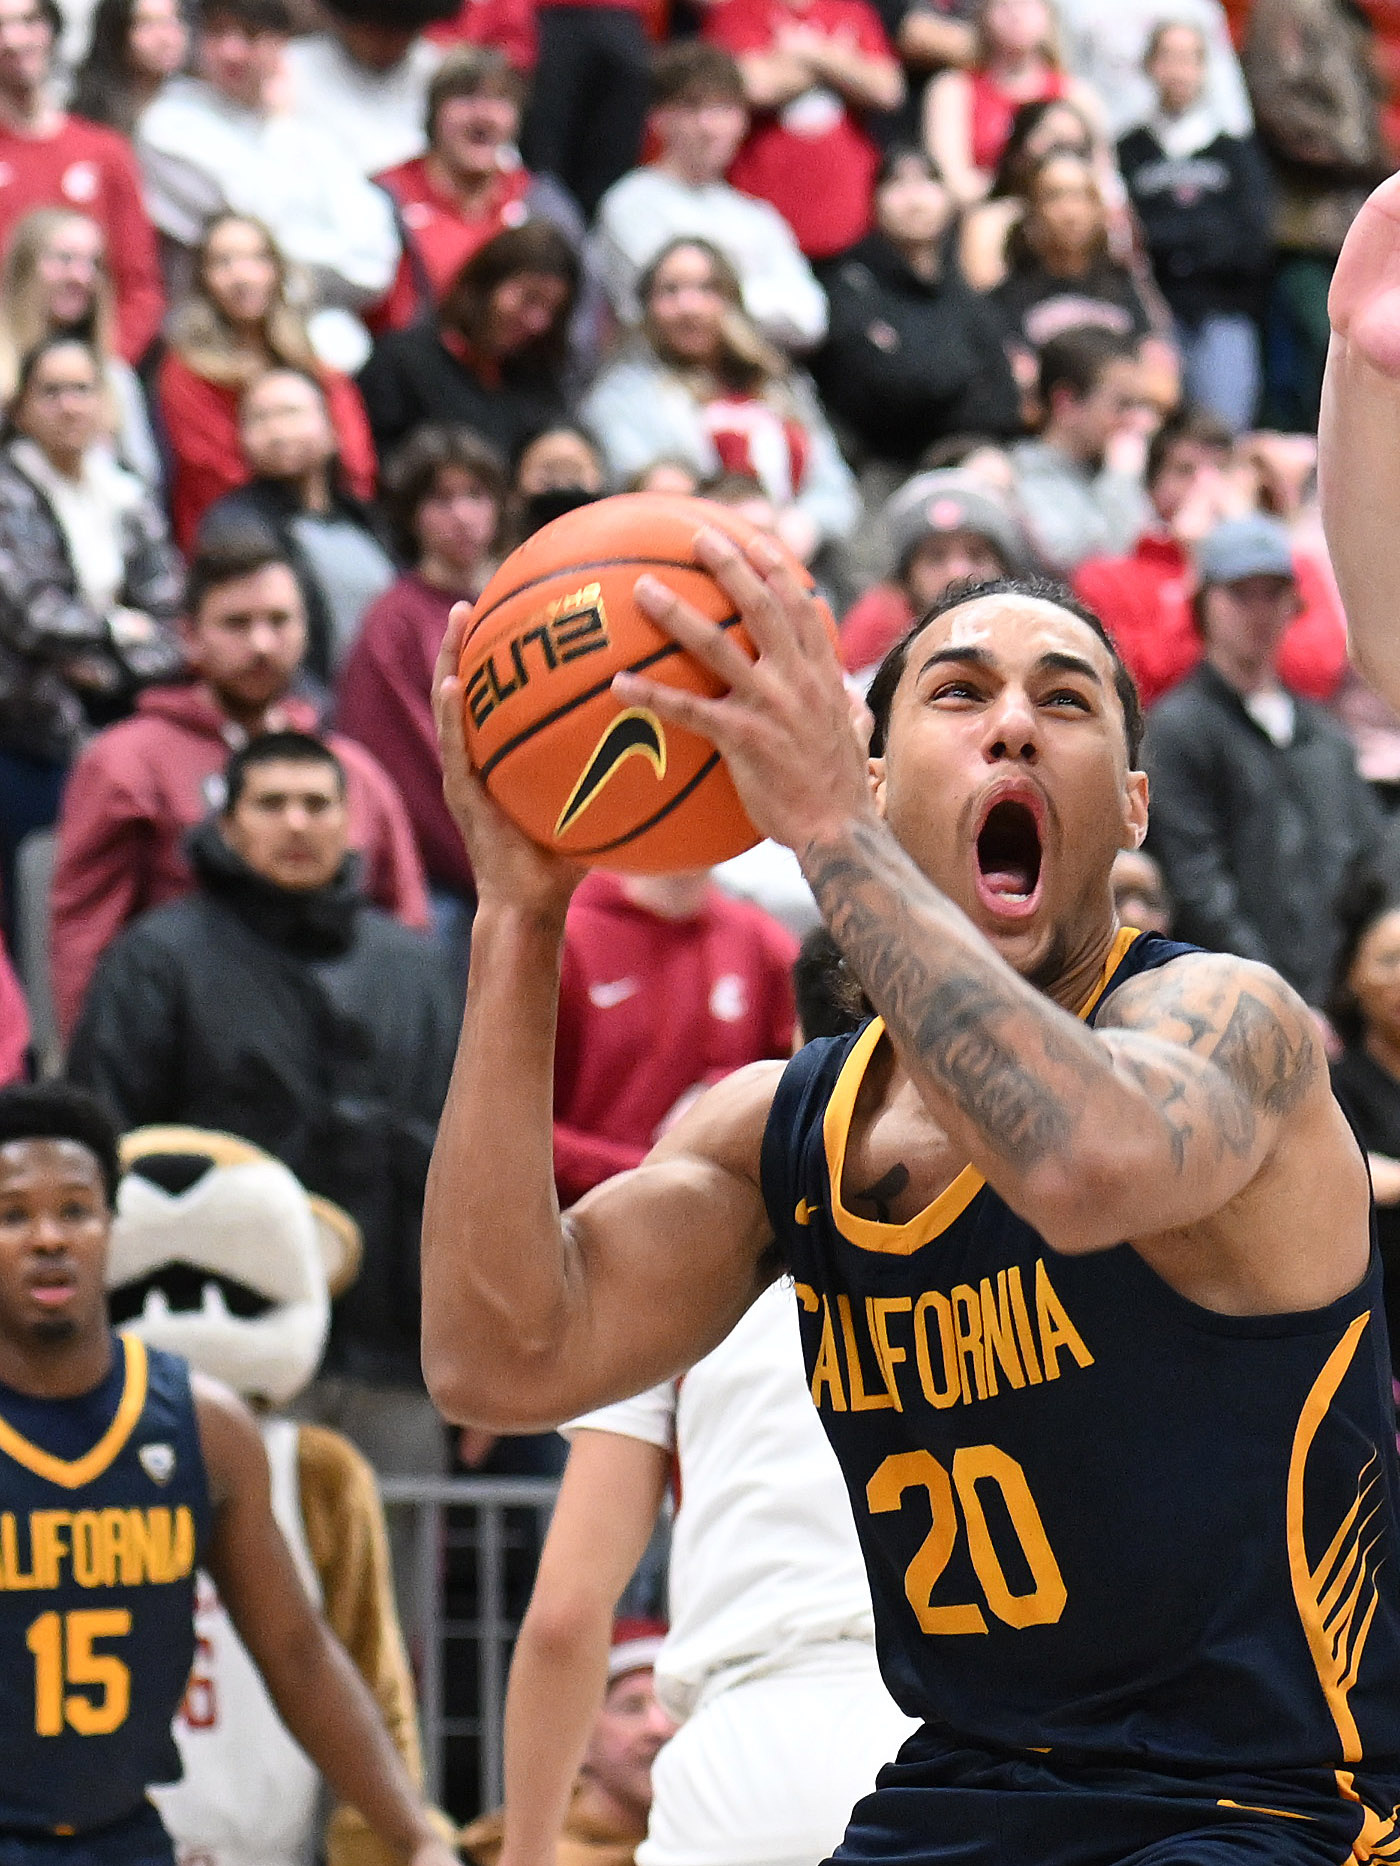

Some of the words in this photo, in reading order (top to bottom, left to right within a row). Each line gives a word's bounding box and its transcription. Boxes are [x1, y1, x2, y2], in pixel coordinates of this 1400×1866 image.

[464, 605, 610, 732] ELITE
[0, 1505, 196, 1591] LIFORNIA
[866, 1444, 1068, 1635] 20
[26, 1607, 132, 1737] 15
